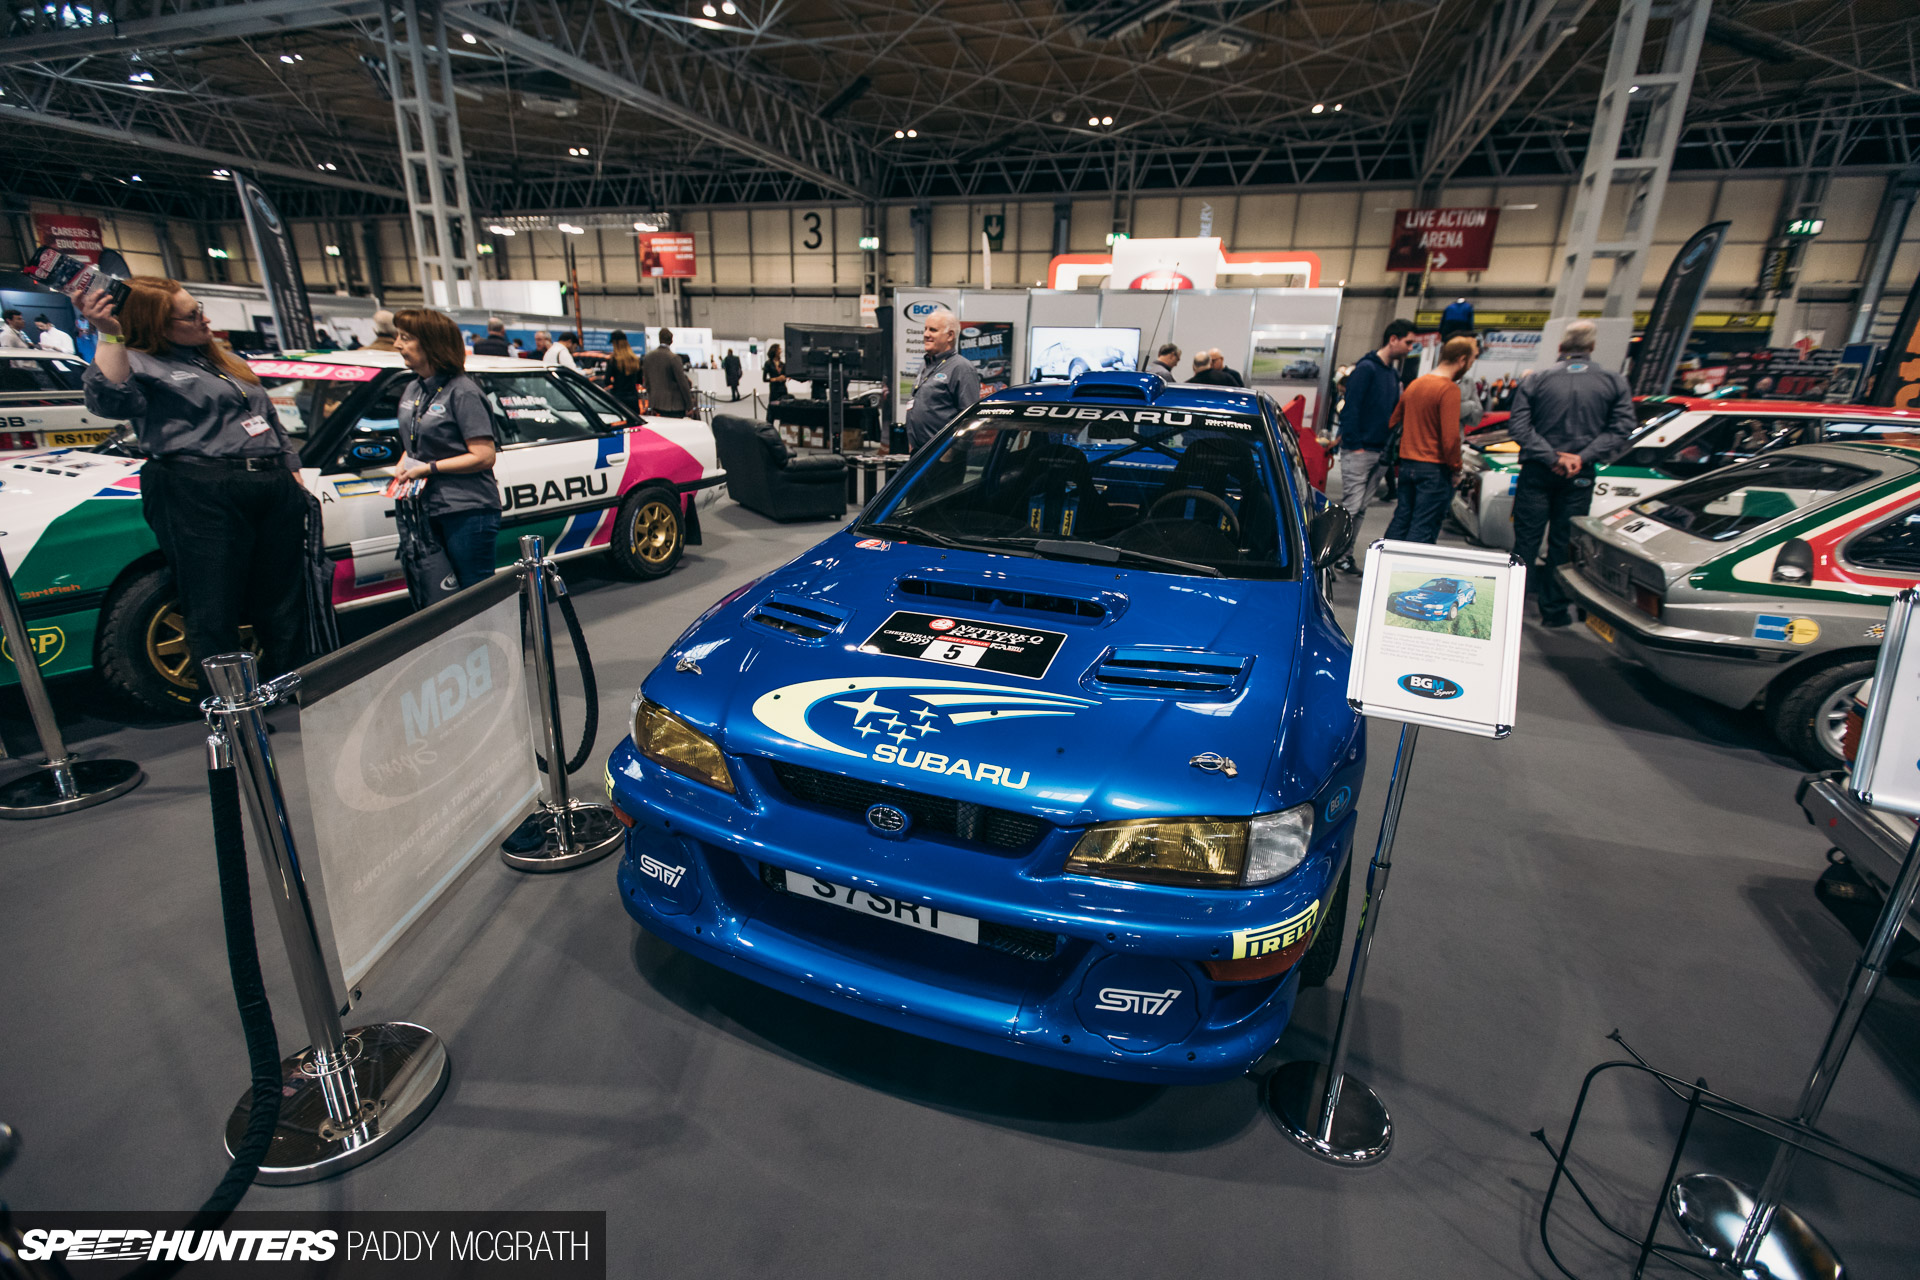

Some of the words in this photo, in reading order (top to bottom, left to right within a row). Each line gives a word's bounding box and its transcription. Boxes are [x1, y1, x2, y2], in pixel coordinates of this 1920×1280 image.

[1405, 211, 1436, 228] LIVE
[1437, 209, 1487, 227] ACTION
[51, 226, 90, 238] CAREERS
[91, 229, 99, 239] &
[803, 212, 822, 249] 3
[55, 239, 102, 250] EDUCATION
[1419, 231, 1464, 248] ARENA
[991, 334, 1003, 345] SEE
[247, 361, 334, 378] BARU
[512, 395, 547, 406] McRae
[1023, 406, 1193, 426] SUBARU
[54, 432, 112, 445] RS1700
[883, 629, 935, 640] CHELTENHAM
[896, 635, 931, 646] 1999
[937, 635, 960, 643] GREAT
[960, 639, 990, 647] BRITAIN
[946, 629, 1021, 645] RALLY
[954, 624, 1030, 641] NETWORK
[1027, 635, 1044, 645] Q
[943, 645, 964, 660] 5
[1410, 675, 1445, 691] BGM
[1433, 688, 1456, 698] Sport
[872, 743, 1030, 790] SUBARU
[1232, 899, 1320, 960] PIRELLI
